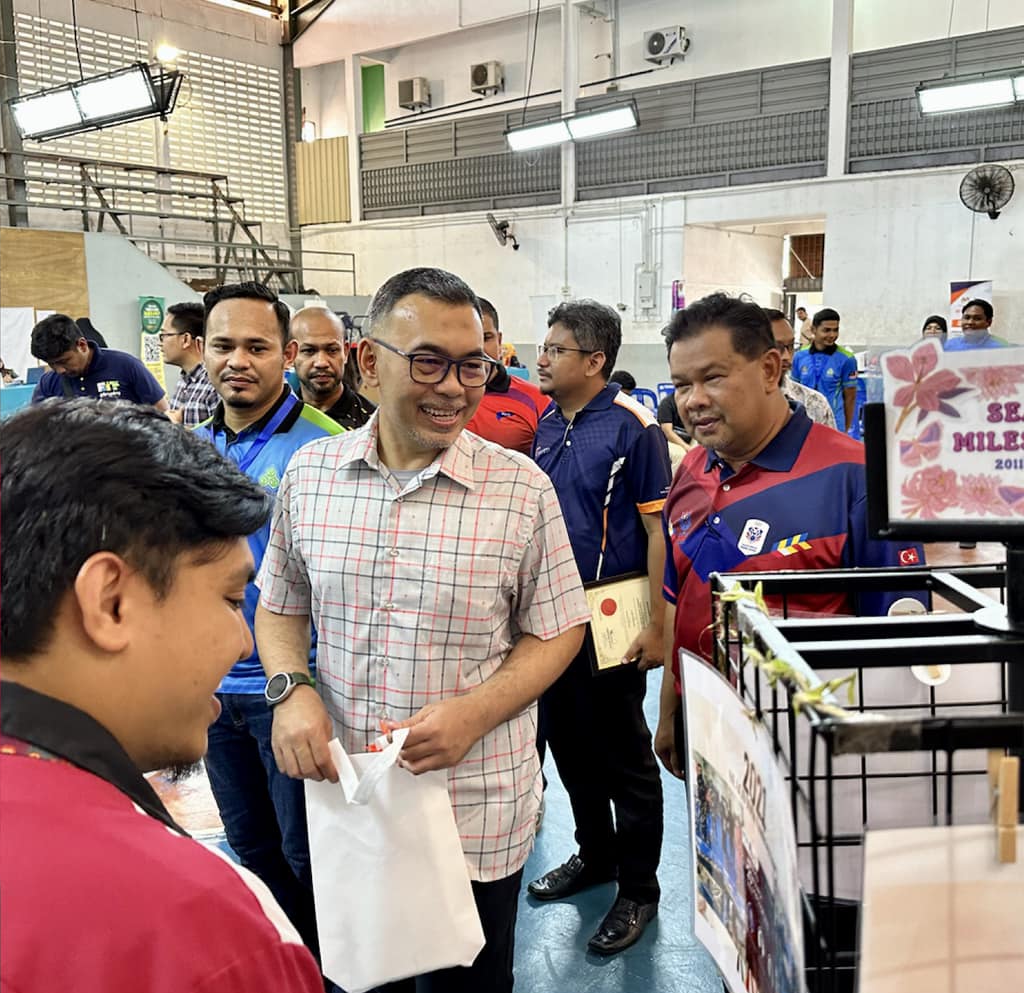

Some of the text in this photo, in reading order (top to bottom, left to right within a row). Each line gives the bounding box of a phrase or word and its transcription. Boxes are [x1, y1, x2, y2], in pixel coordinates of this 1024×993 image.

[987, 401, 1024, 423] SE
[953, 431, 1024, 452] MILE
[995, 459, 1024, 470] 2011
